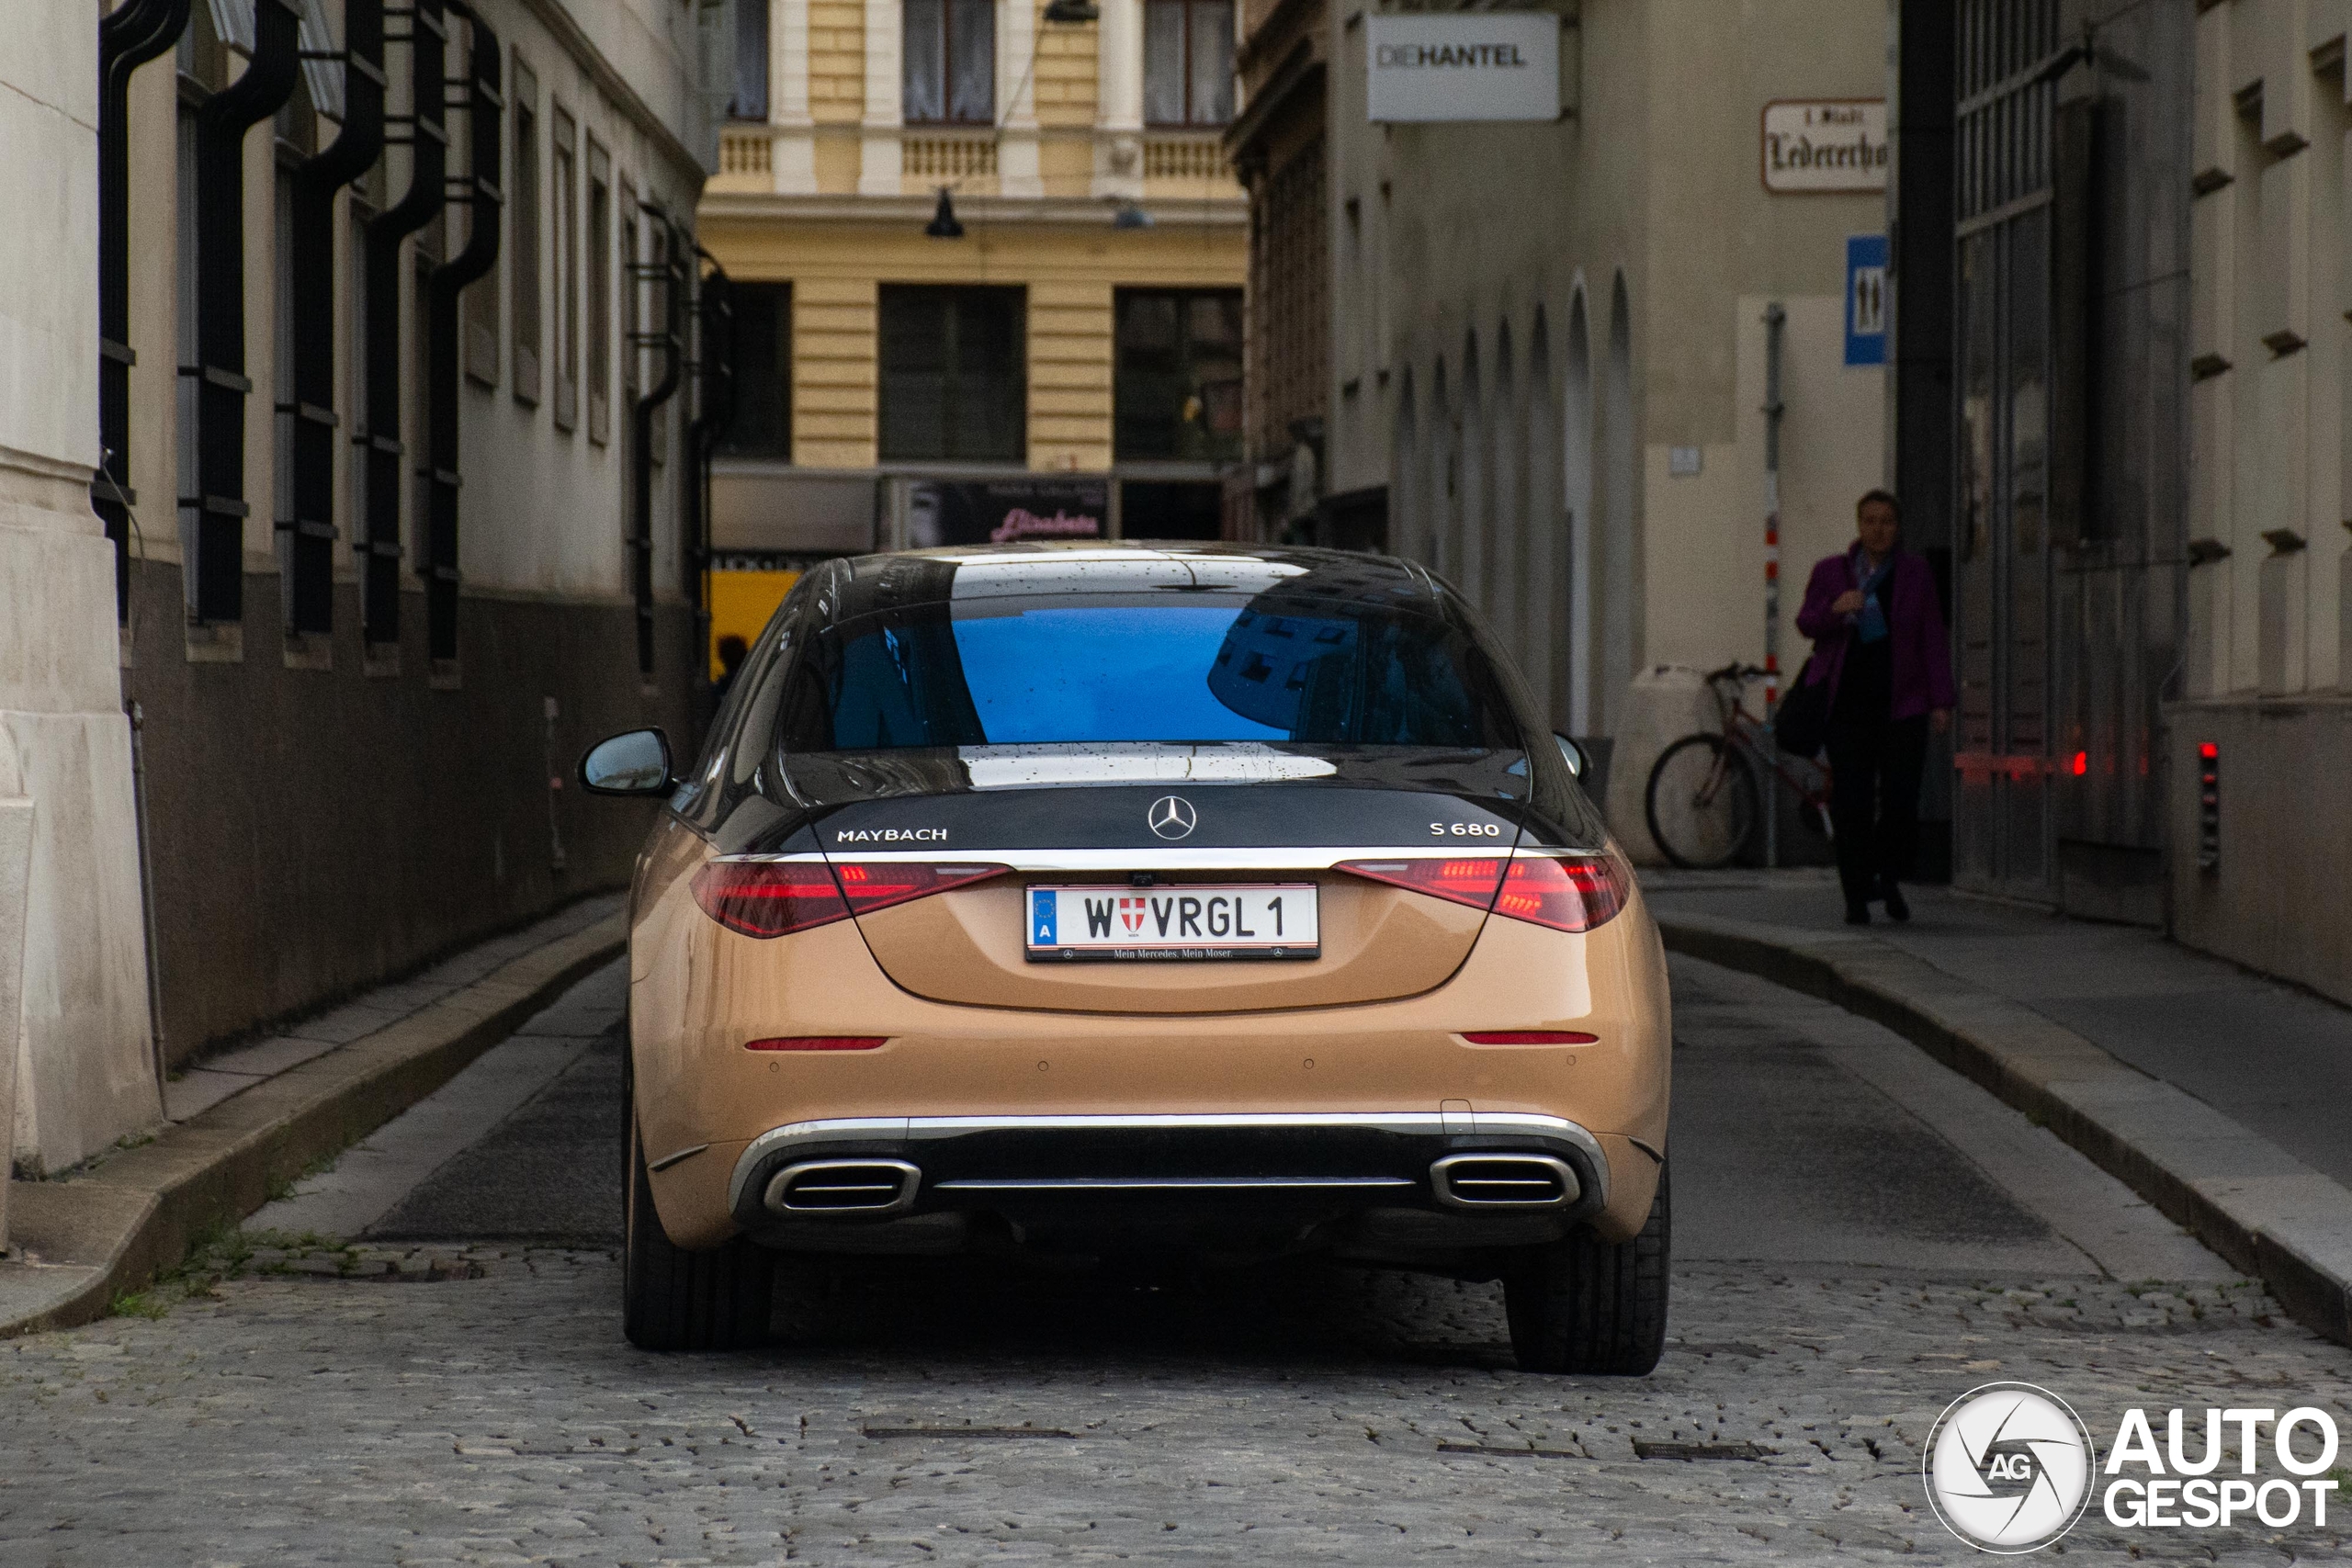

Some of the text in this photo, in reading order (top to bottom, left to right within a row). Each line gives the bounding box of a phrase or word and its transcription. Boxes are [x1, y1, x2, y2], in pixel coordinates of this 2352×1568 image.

[837, 829, 947, 842] MAYBACH
[1430, 823, 1500, 837] S 680
[1084, 897, 1283, 938] W VRGL 1
[1039, 924, 1051, 938] A
[1114, 948, 1233, 959] Mein Mercedes. Mein Moser.
